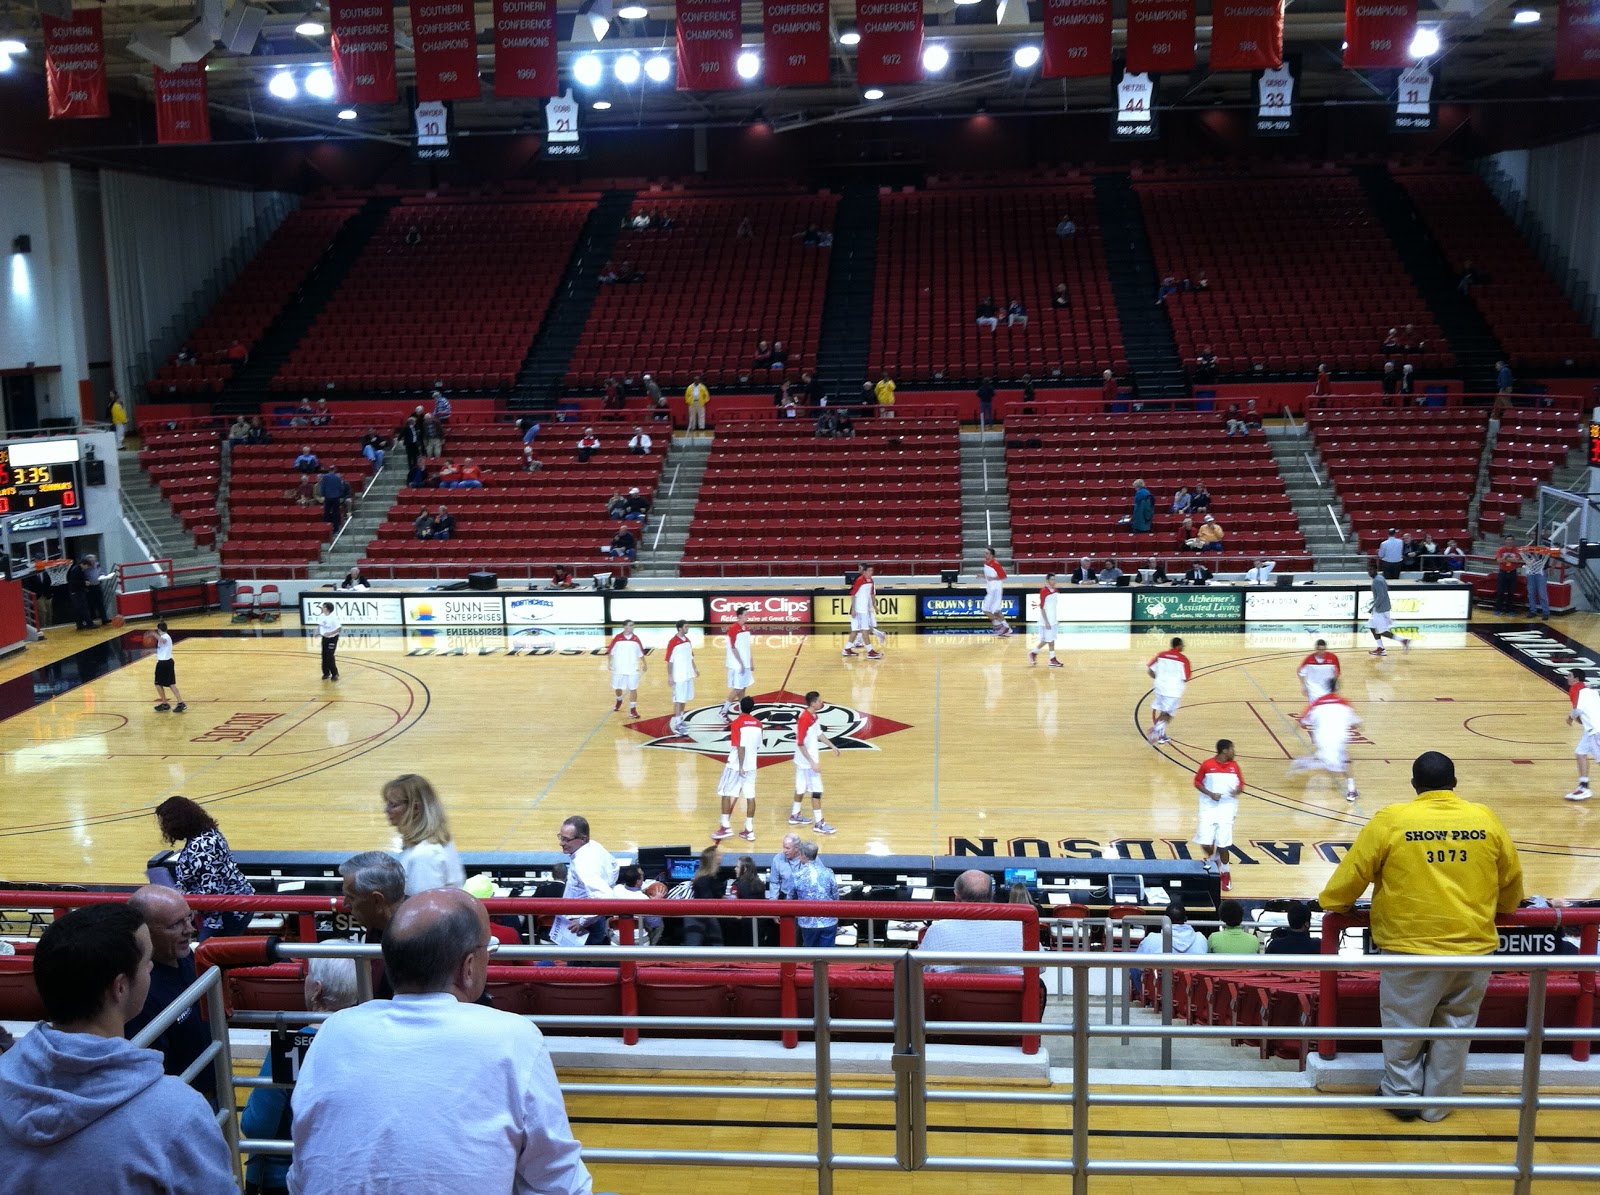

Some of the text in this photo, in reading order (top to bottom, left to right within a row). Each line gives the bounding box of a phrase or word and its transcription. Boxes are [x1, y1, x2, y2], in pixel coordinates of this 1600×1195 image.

[339, 7, 383, 18] SOUTHERN
[420, 4, 464, 17] SOUTHERN
[502, 1, 546, 12] SOUTHERN
[768, 3, 824, 16] CONFERENCE
[860, 2, 919, 16] CONFERENCE
[1224, 6, 1274, 17] CHAMPIONS
[1355, 4, 1408, 17] CHAMPIONS
[681, 11, 737, 22] CONFERENCE
[1053, 13, 1105, 26] CHAMPIONS
[1135, 9, 1188, 22] CHAMPIONS
[336, 24, 390, 37] CONFERENCE
[417, 21, 471, 34] CONFERENCE
[498, 19, 552, 30] CONFERENCE
[772, 21, 821, 34] CHAMPIONS
[864, 20, 916, 33] CHAMPIONS
[52, 26, 93, 38] SOUTHERN
[685, 29, 734, 41] CHAMPIONS
[341, 41, 388, 54] CHAMPIONS
[422, 39, 469, 52] CHAMPIONS
[502, 37, 550, 48] CHAMPIONS
[50, 44, 99, 55] CONFERENCE
[1067, 47, 1088, 58] 1973
[54, 60, 98, 71] CHAMPIONS
[788, 54, 806, 66] 1971
[882, 54, 902, 65] 1972
[700, 62, 720, 73] 1970
[517, 69, 536, 80] 1969
[1266, 93, 1285, 108] 33
[1406, 90, 1419, 104] 11
[1125, 98, 1144, 113] 44
[424, 122, 439, 136] 10
[556, 119, 570, 133] 21
[63, 490, 76, 506] 0
[927, 600, 966, 609] CROWN
[1137, 594, 1178, 603] Preston
[1187, 594, 1236, 603] Alzheimer's
[336, 602, 378, 616] MAIN
[445, 601, 482, 613] SUNN
[710, 598, 808, 616] Great Clips
[1176, 603, 1240, 612] Assisted Living
[1405, 829, 1487, 842] SHOW PROS
[1427, 849, 1468, 863] 3073
[1497, 934, 1556, 953] DENTS
